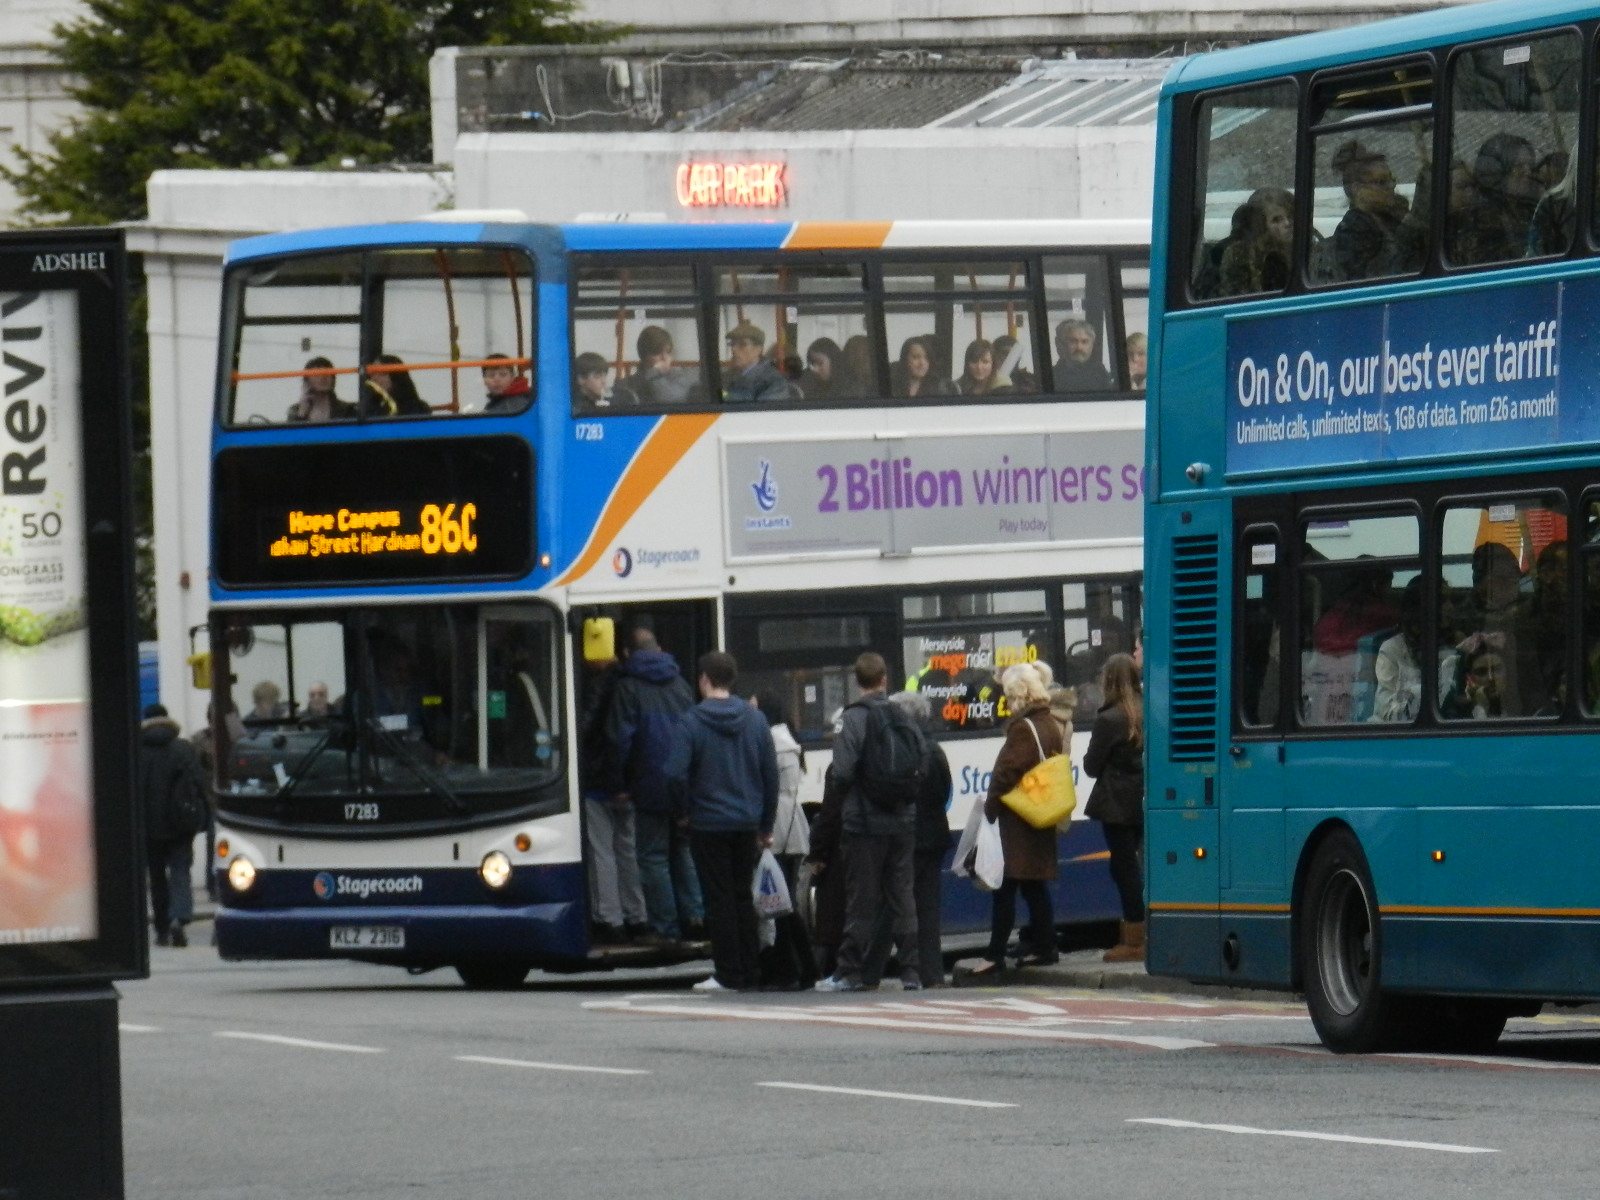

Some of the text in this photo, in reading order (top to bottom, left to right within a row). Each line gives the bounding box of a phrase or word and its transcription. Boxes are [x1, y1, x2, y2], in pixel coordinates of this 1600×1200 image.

[1238, 320, 1559, 408] On & On, our best ever tariff.
[1236, 391, 1558, 445] Unlimited calls, unlimited texts, 1GB of data. From £26 a month
[816, 455, 1145, 514] 2 Billion winners s
[22, 511, 62, 539] 50
[420, 503, 478, 555] 86C
[999, 516, 1048, 535] Play today
[637, 548, 699, 567] Stagecoach
[920, 638, 966, 653] Merseyside
[931, 651, 991, 676] megarider
[922, 683, 968, 699] Merseyside
[942, 697, 994, 725] dayrider
[344, 803, 379, 820] 17283
[337, 875, 423, 898] Stagecoach
